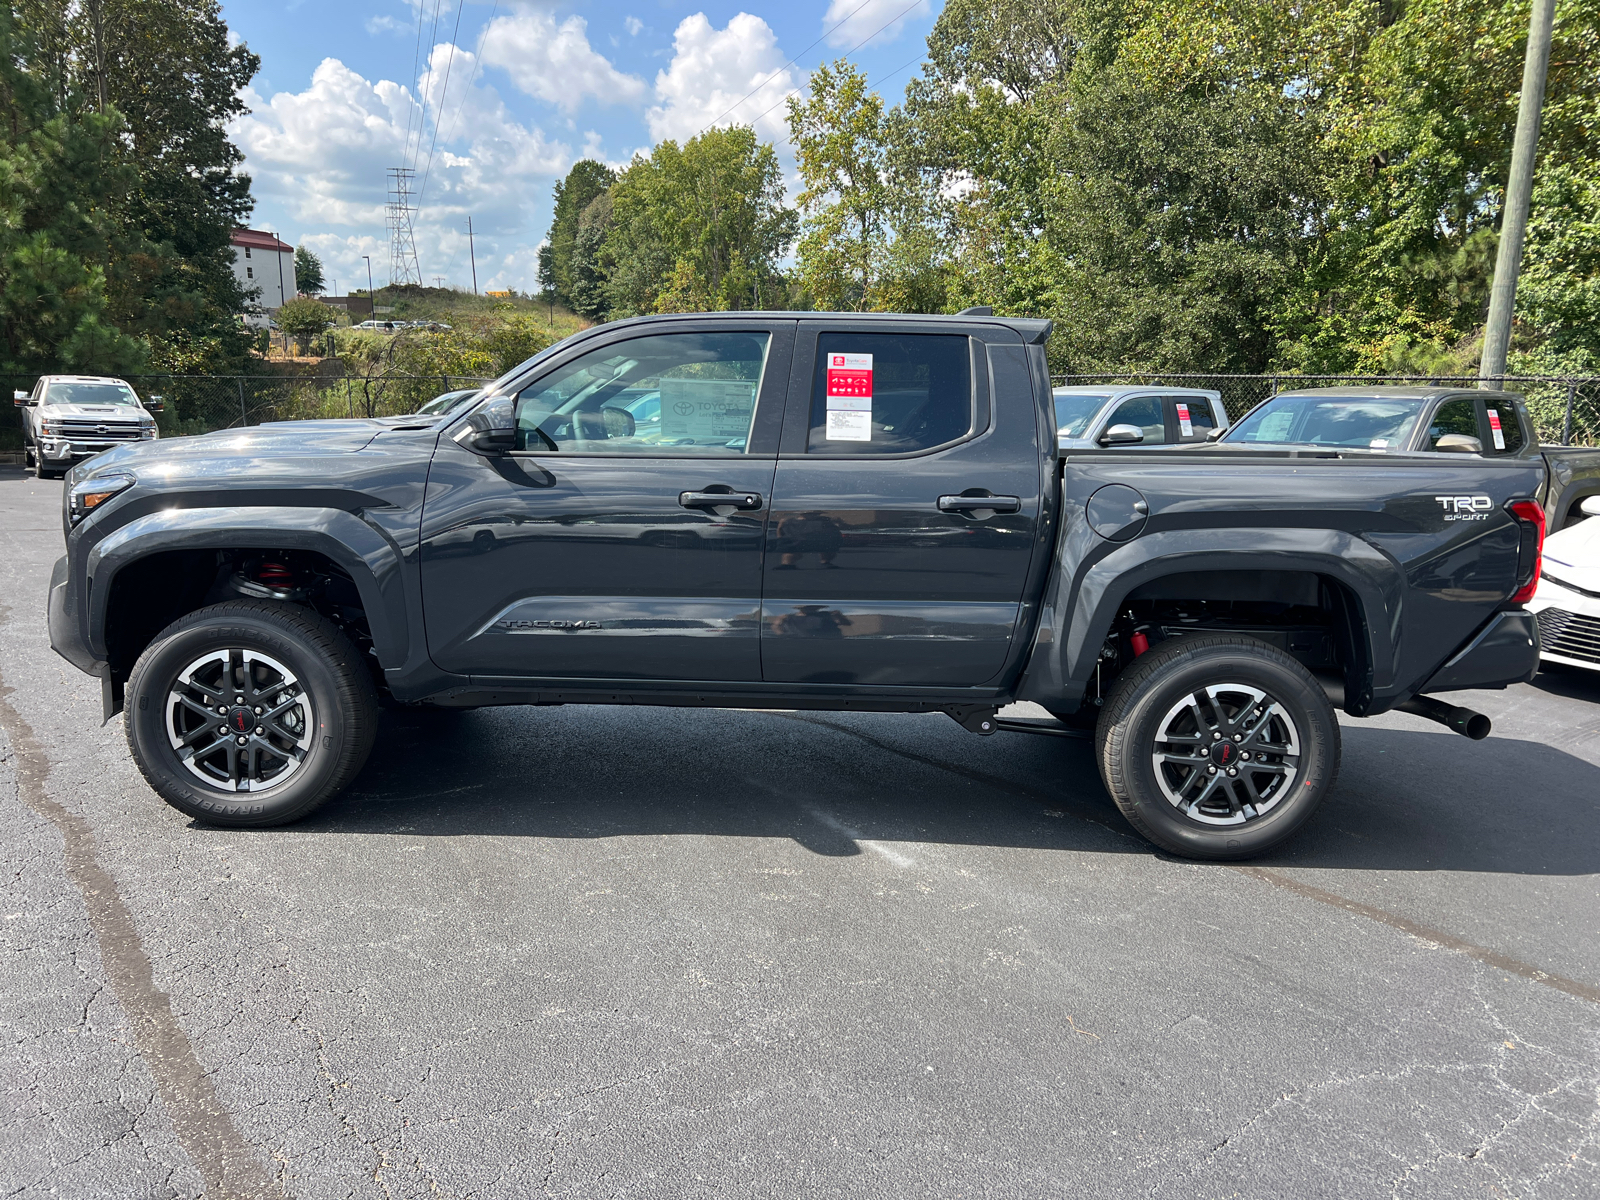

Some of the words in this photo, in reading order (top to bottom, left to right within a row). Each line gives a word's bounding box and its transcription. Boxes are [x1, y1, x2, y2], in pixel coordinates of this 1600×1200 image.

[696, 402, 740, 411] TOYOTA
[1435, 496, 1492, 512] TRD
[1443, 513, 1489, 521] SPORT
[500, 619, 602, 629] TACOMA
[207, 627, 292, 656] GENERAL
[236, 710, 246, 731] TRD
[1221, 744, 1231, 764] TRD
[1306, 708, 1326, 792] GENERAL
[179, 787, 265, 815] GRABBER
